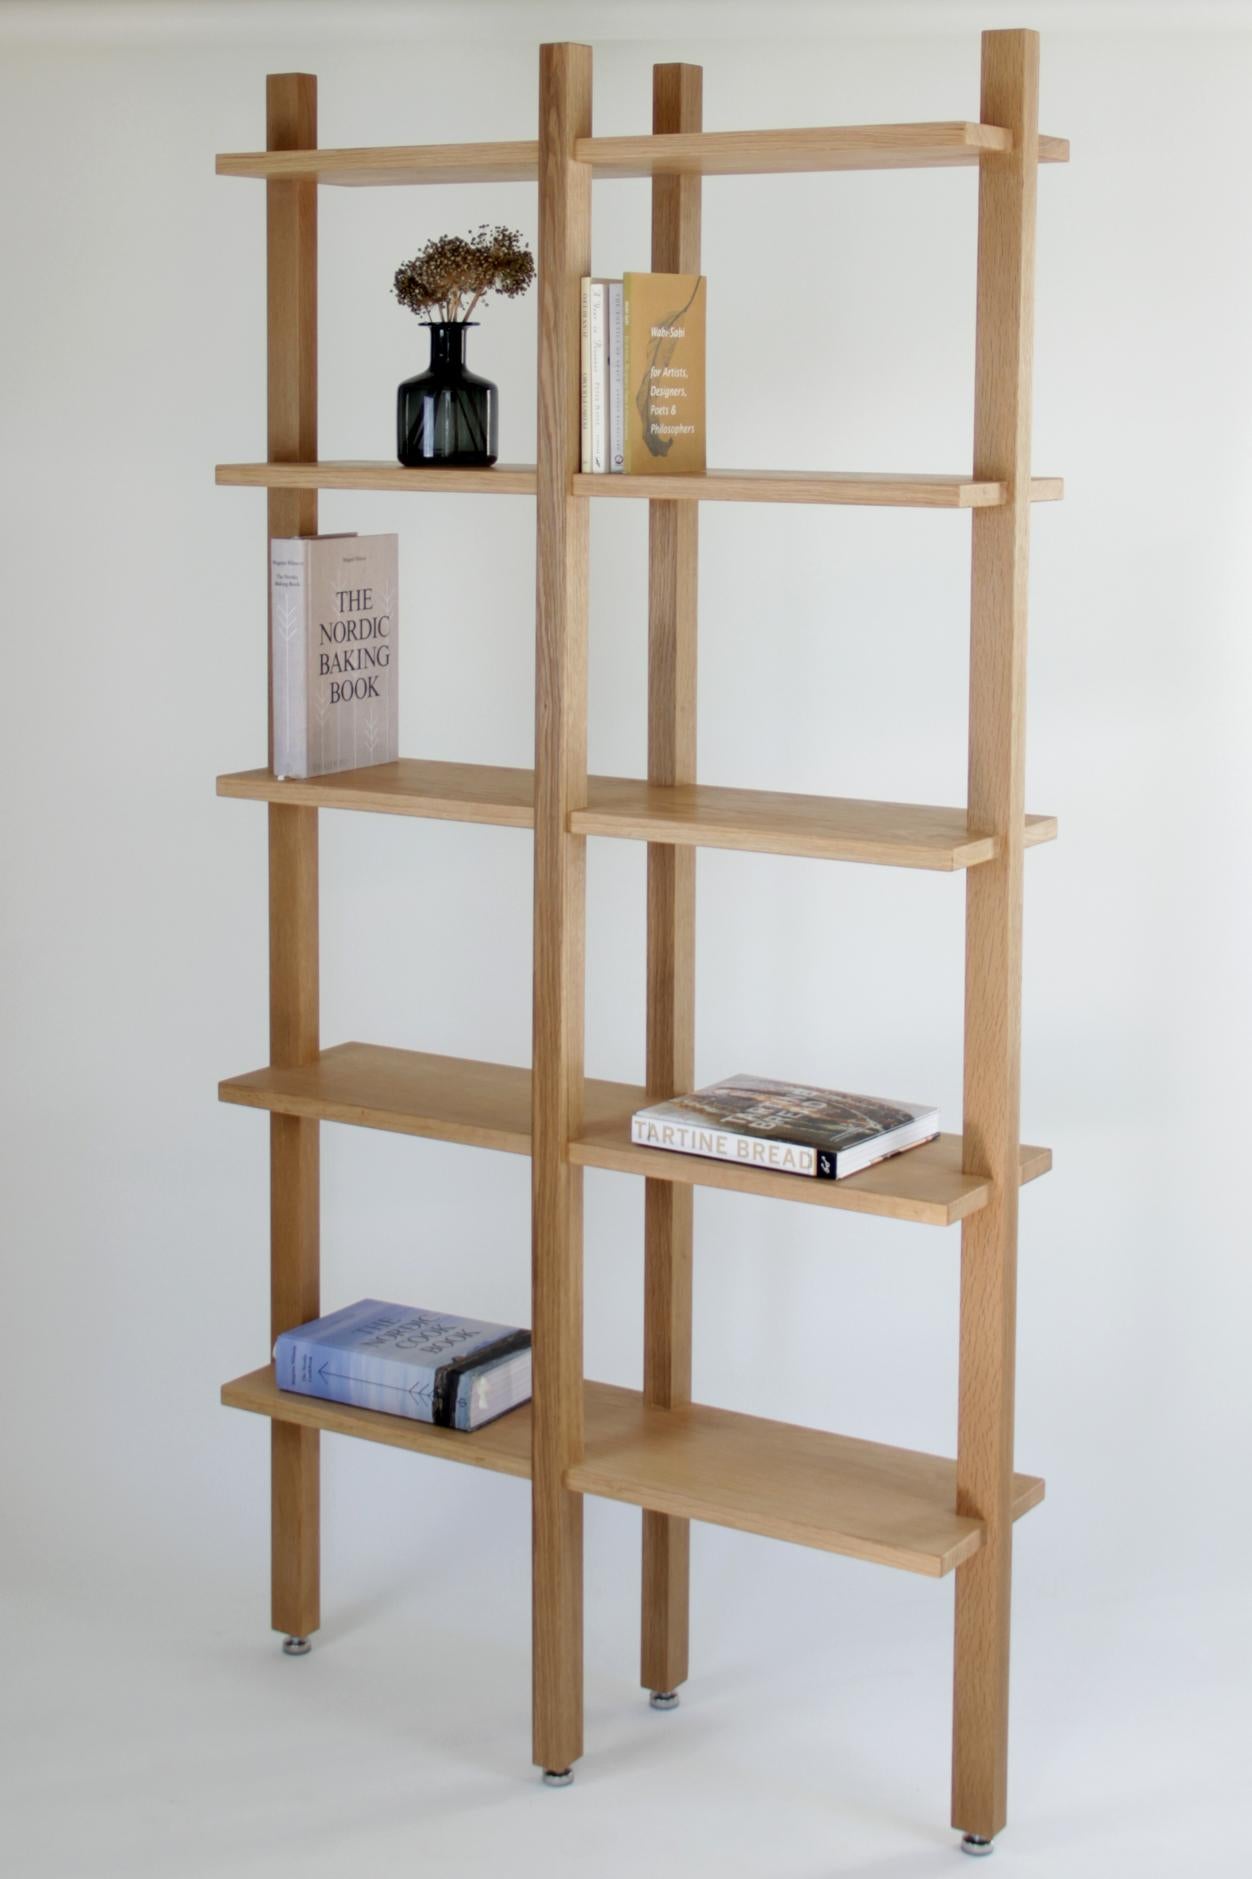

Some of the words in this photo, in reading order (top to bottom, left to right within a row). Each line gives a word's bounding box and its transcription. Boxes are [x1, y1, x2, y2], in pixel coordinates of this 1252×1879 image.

[651, 327, 685, 338] Wabi-Sabi
[650, 366, 661, 378] for
[650, 405, 669, 415] Poets
[650, 423, 695, 437] Philosophers
[336, 588, 373, 613] THE
[319, 615, 390, 645] NORDIC
[319, 645, 390, 676] BAKING
[329, 675, 380, 704] BOOK
[634, 1119, 727, 1155] TARTINE
[736, 1138, 813, 1170] BREAD
[352, 1317, 399, 1336] THE
[395, 1324, 456, 1349] COOK
[420, 1329, 481, 1354] BOOK
